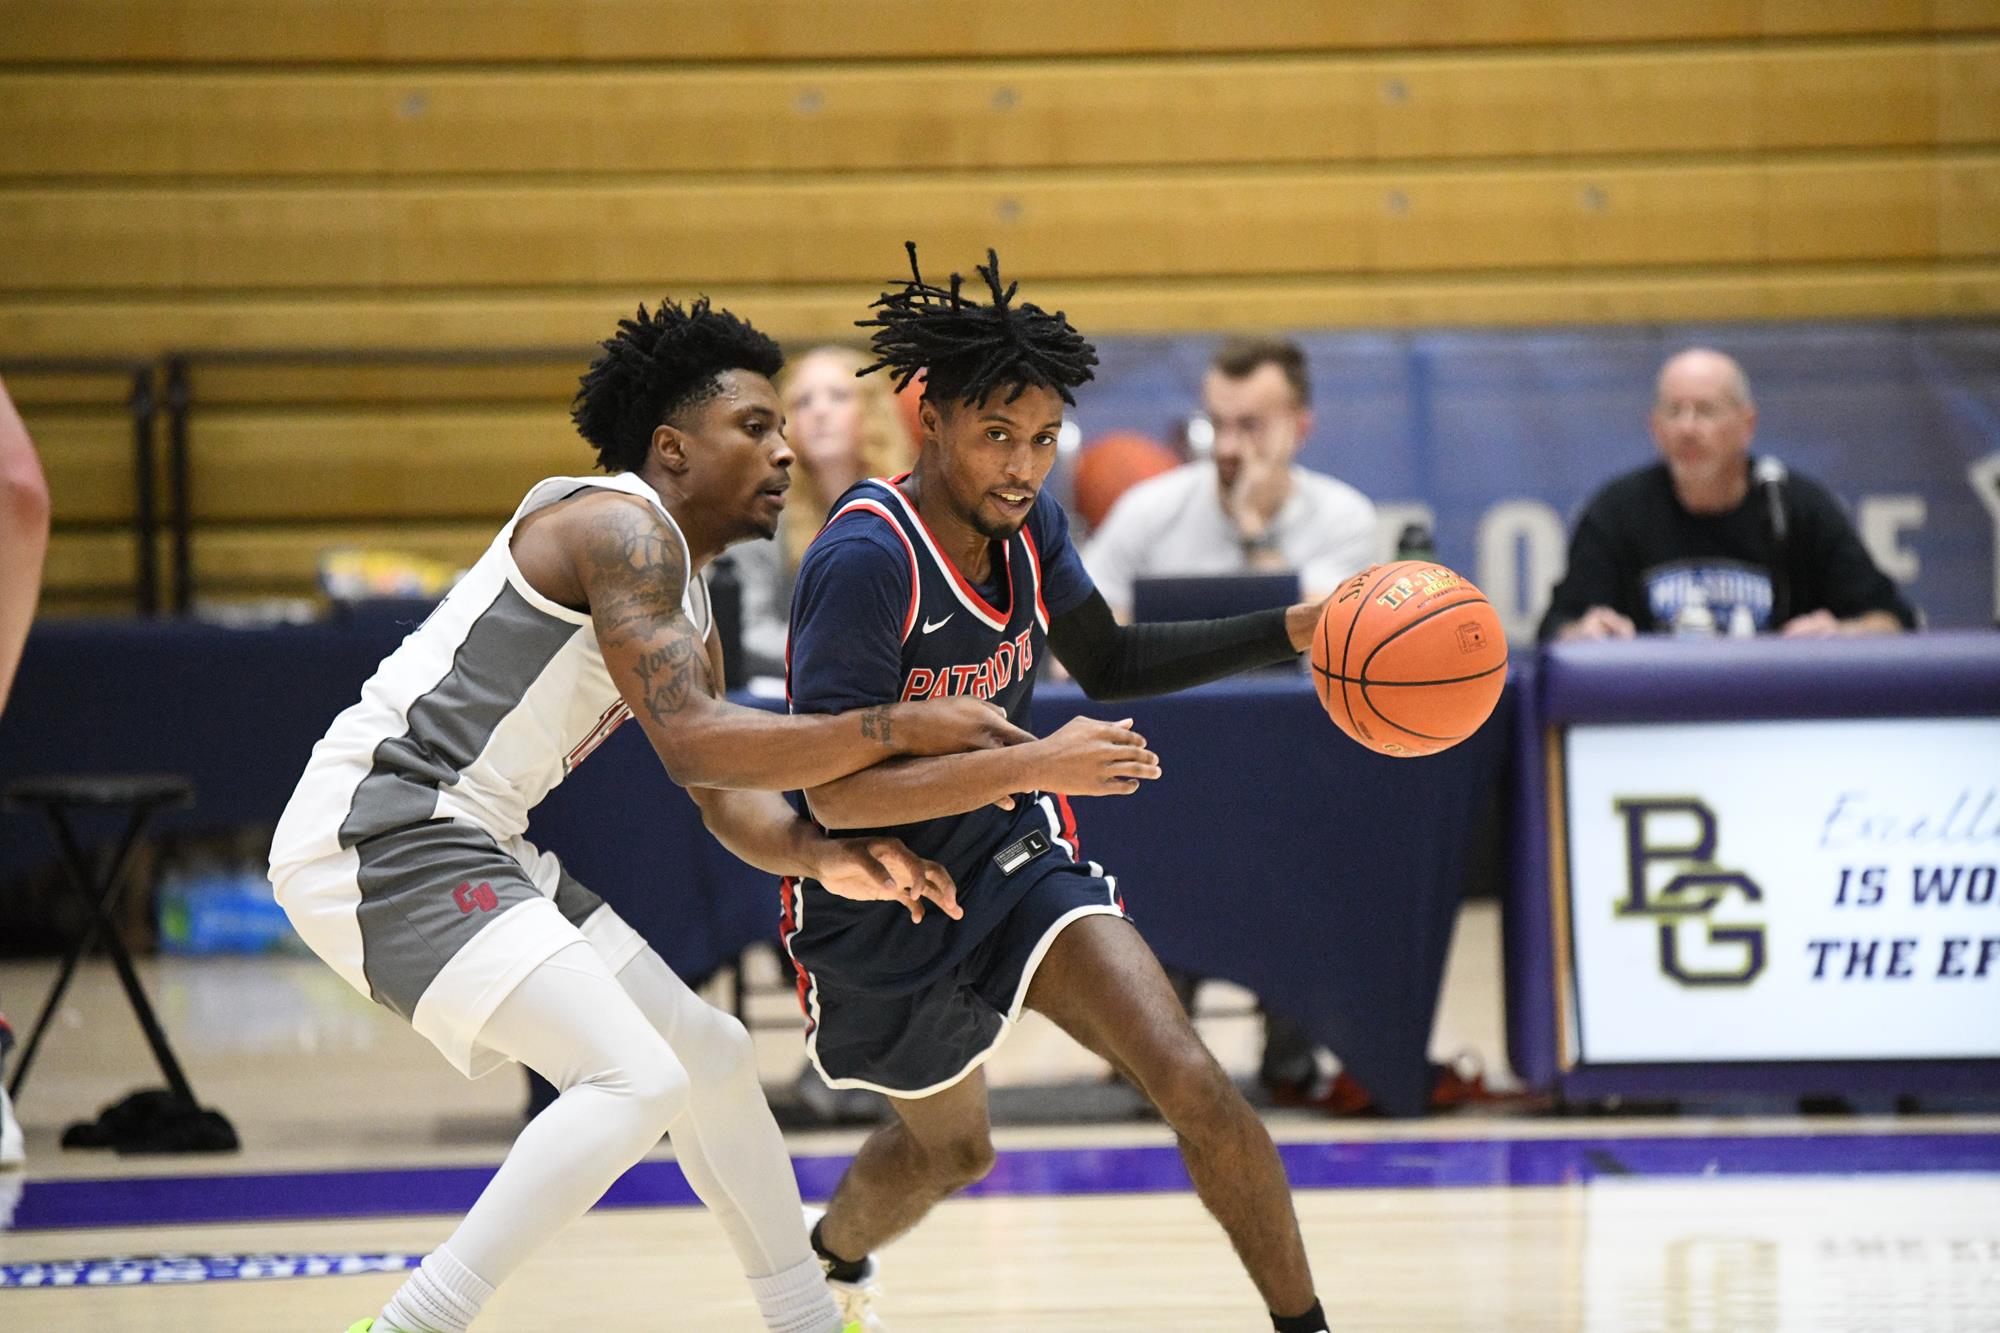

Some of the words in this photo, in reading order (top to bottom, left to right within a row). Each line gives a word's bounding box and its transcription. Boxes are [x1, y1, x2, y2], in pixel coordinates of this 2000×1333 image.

[1834, 866, 1887, 905] IS
[1913, 866, 2000, 905] WO
[1808, 938, 1917, 978] THE
